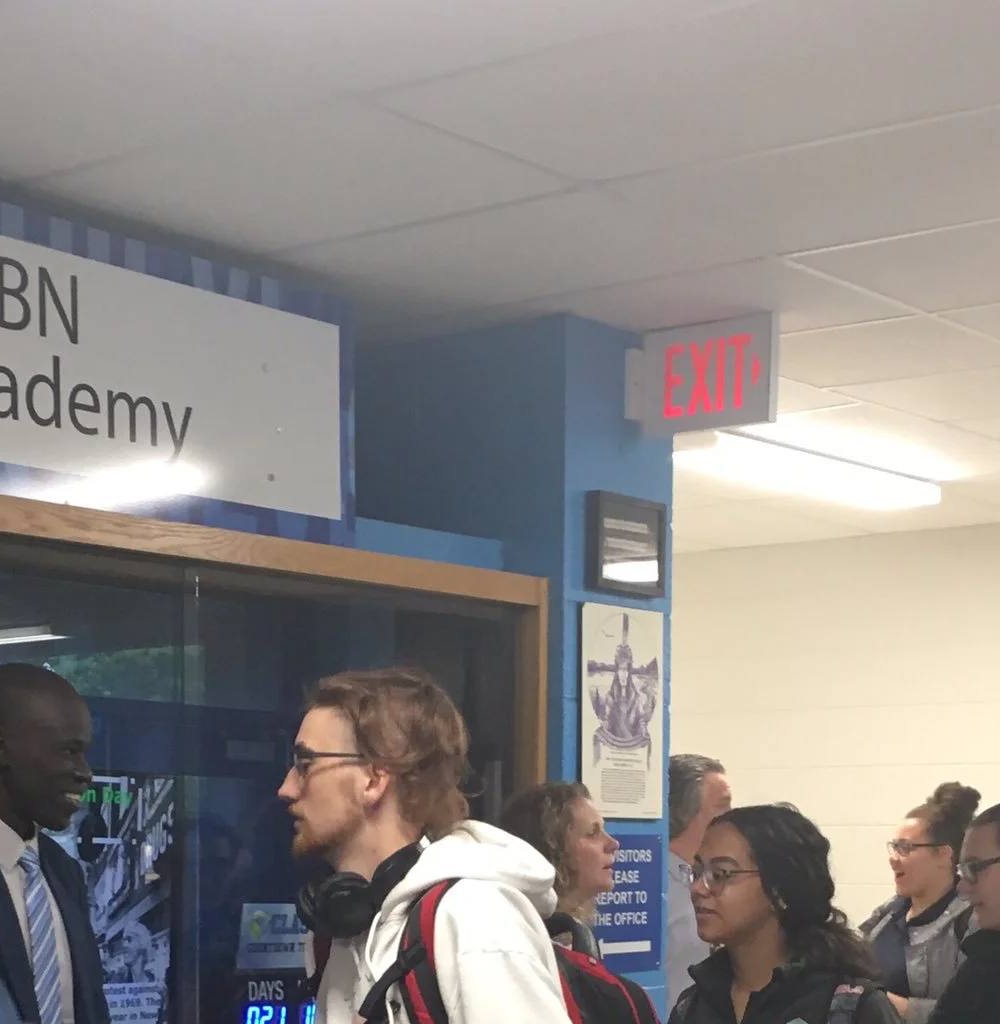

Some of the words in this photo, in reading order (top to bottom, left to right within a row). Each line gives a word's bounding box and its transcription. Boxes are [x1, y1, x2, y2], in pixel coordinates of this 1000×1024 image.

[662, 333, 752, 419] EXIT
[612, 869, 640, 884] EASE
[634, 890, 648, 904] TO
[613, 911, 647, 926] OFFICE
[247, 980, 285, 1002] DAYS
